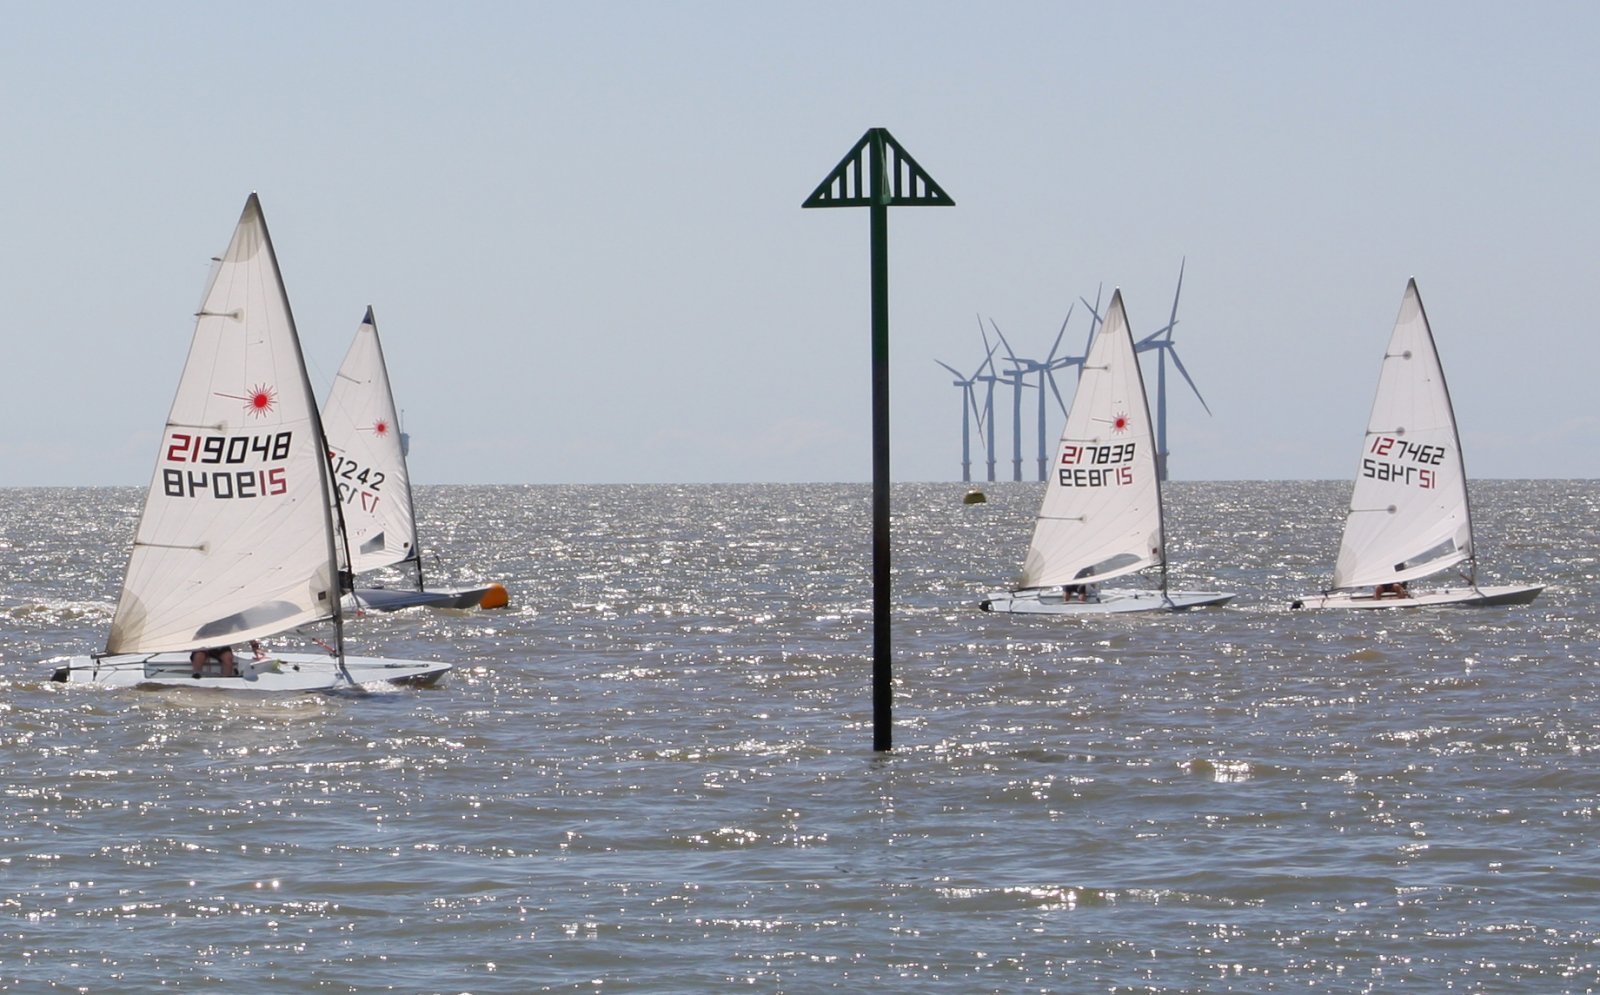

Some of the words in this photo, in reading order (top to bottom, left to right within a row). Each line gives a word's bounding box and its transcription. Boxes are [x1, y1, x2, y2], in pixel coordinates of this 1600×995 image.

[167, 431, 293, 464] 219048
[1061, 443, 1136, 464] 217839
[1370, 436, 1446, 466] 127462
[327, 451, 386, 491] 1242
